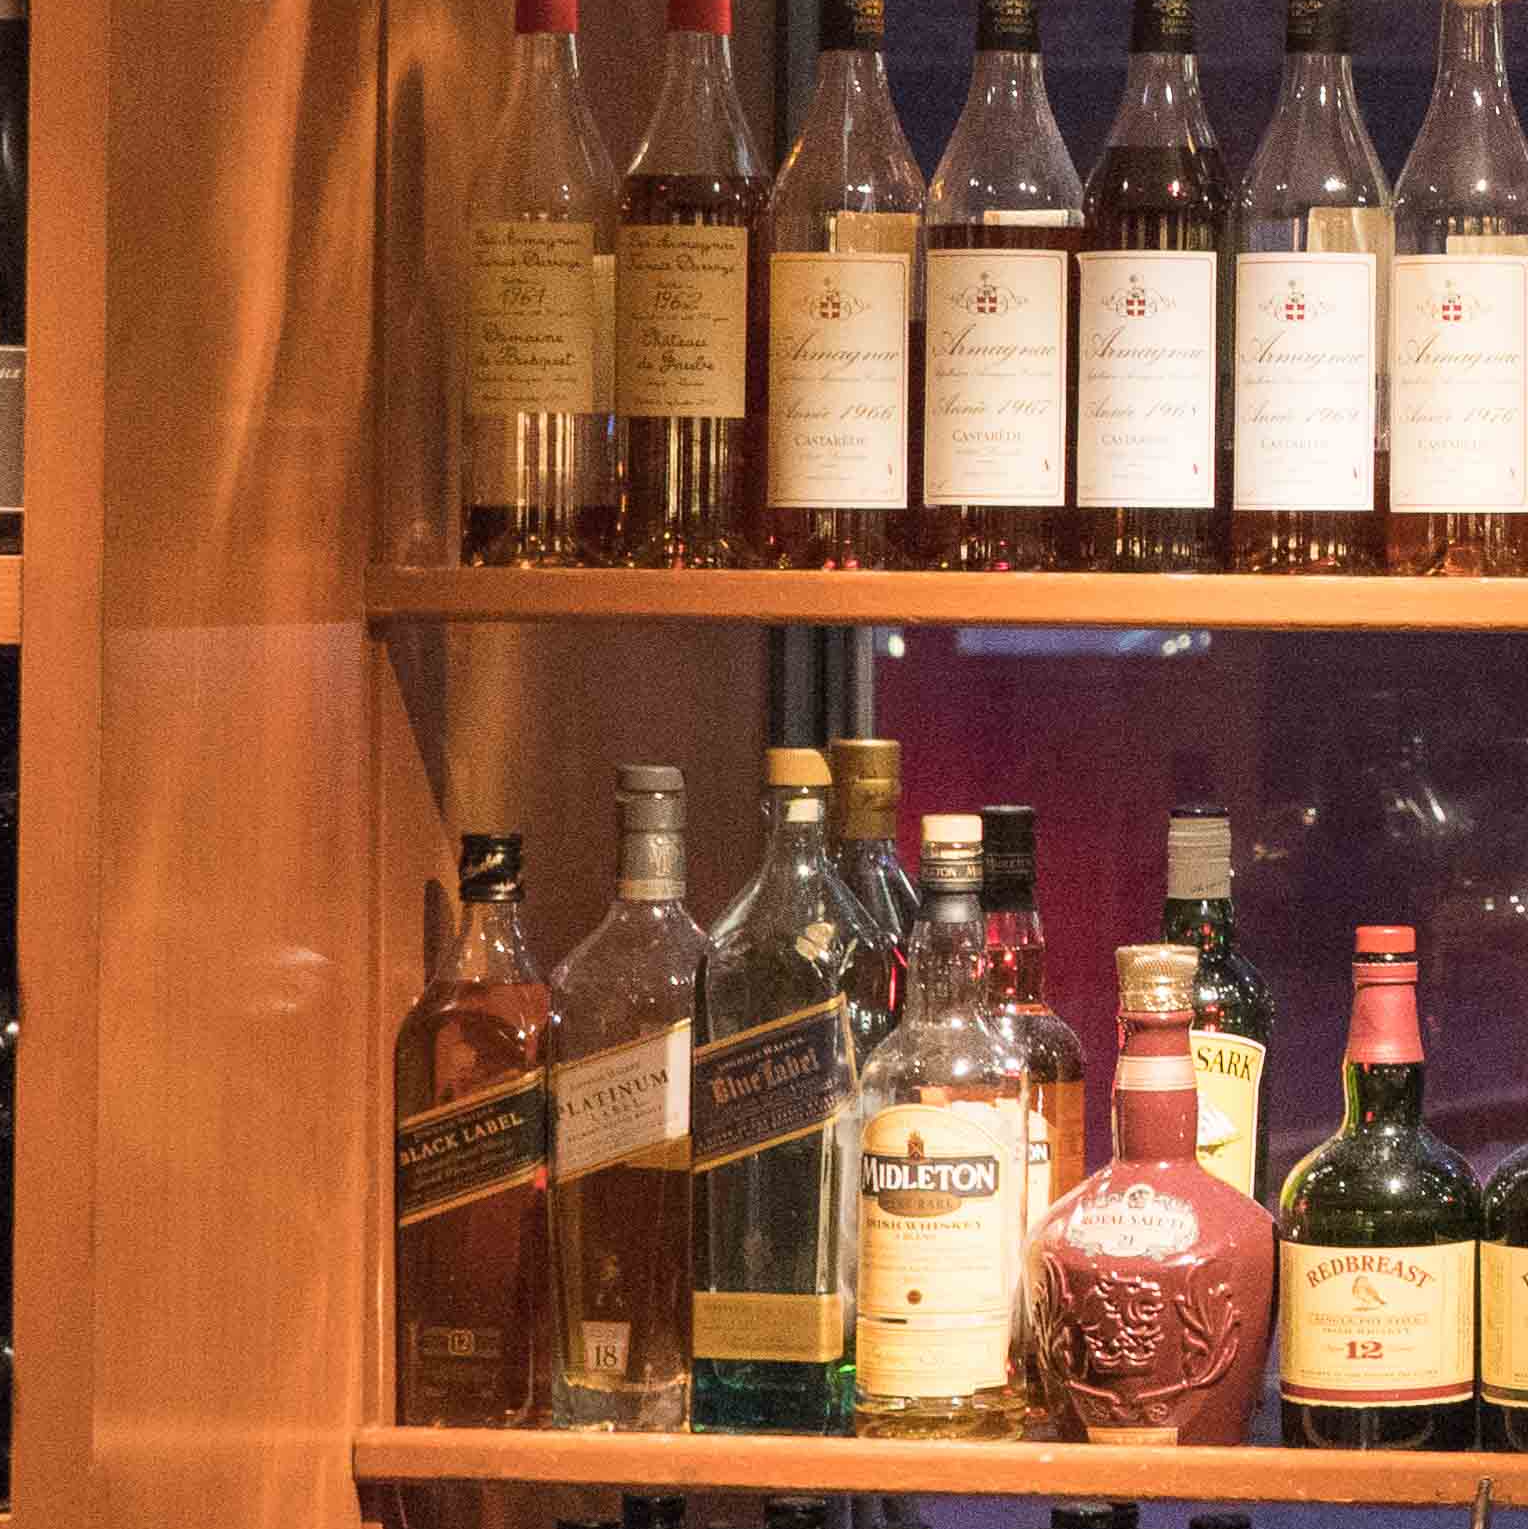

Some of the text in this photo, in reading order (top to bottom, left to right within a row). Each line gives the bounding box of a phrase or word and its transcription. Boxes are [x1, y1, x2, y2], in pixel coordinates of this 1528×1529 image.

[711, 1047, 821, 1105] Blue Label
[1195, 1046, 1256, 1082] SARK
[560, 1069, 669, 1118] LATINUM
[400, 1110, 522, 1167] BLACK LABEL
[864, 1160, 997, 1192] MIDLETON
[1305, 1253, 1435, 1290] REDBREAST
[592, 1344, 617, 1368] 18
[1344, 1339, 1385, 1361] 12
